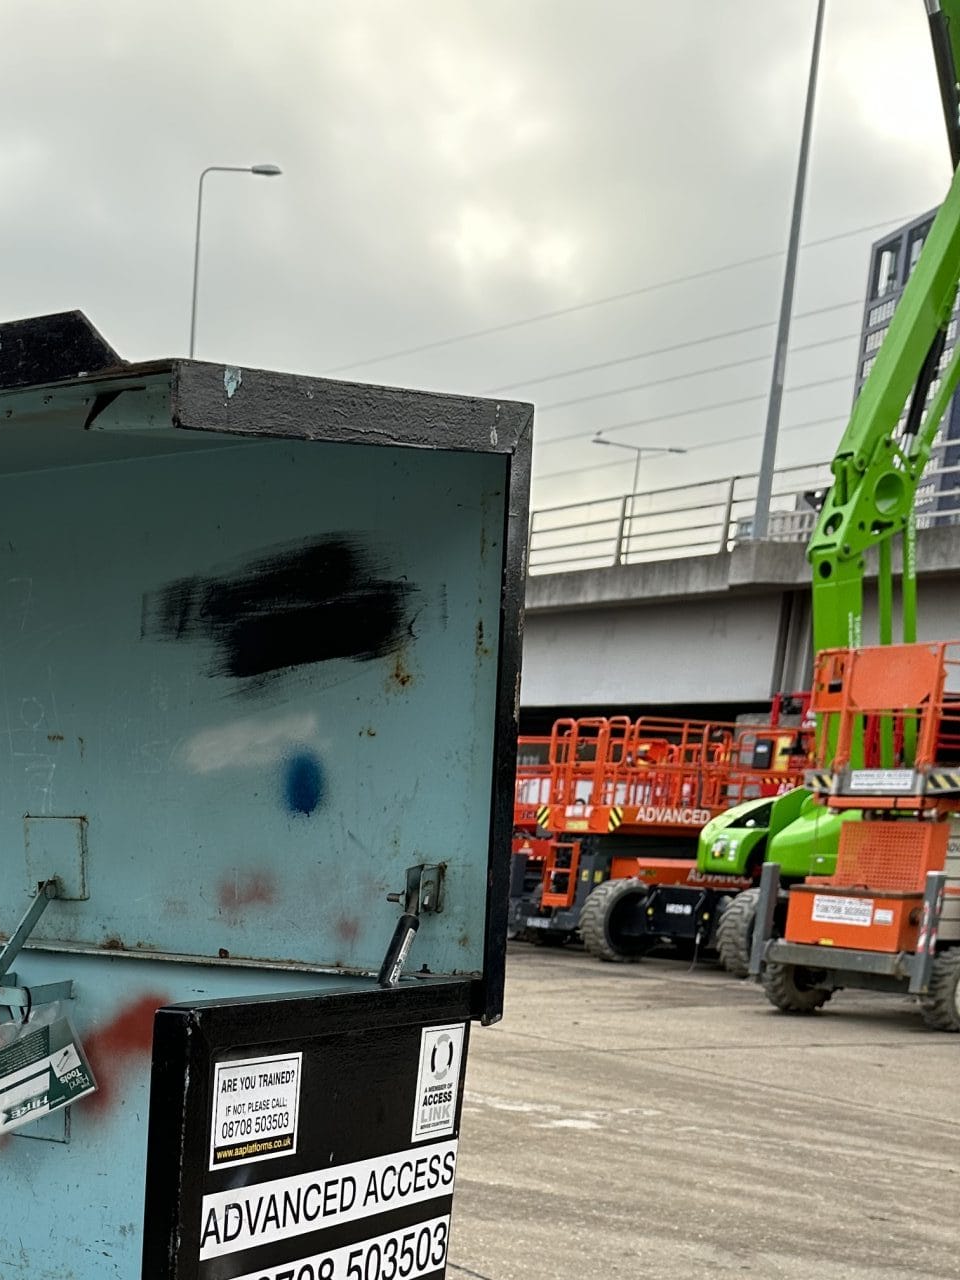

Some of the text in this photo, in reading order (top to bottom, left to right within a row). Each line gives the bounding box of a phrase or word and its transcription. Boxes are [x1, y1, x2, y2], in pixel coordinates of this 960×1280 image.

[636, 806, 711, 824] ADVANCED
[60, 1068, 83, 1084] Tools
[68, 1074, 90, 1091] Hand
[221, 1069, 295, 1093] ARE YOU TRAINED?
[428, 1083, 446, 1092] MEMBER
[225, 1105, 231, 1116] IF
[248, 1099, 270, 1113] PLEASE
[422, 1091, 453, 1107] ACCESS
[421, 1104, 451, 1123] LINK
[222, 1112, 289, 1139] 08708 503503
[216, 1136, 291, 1159] www.aaplatforms.co.uk
[200, 1151, 456, 1249] ADVANCED ACCESS
